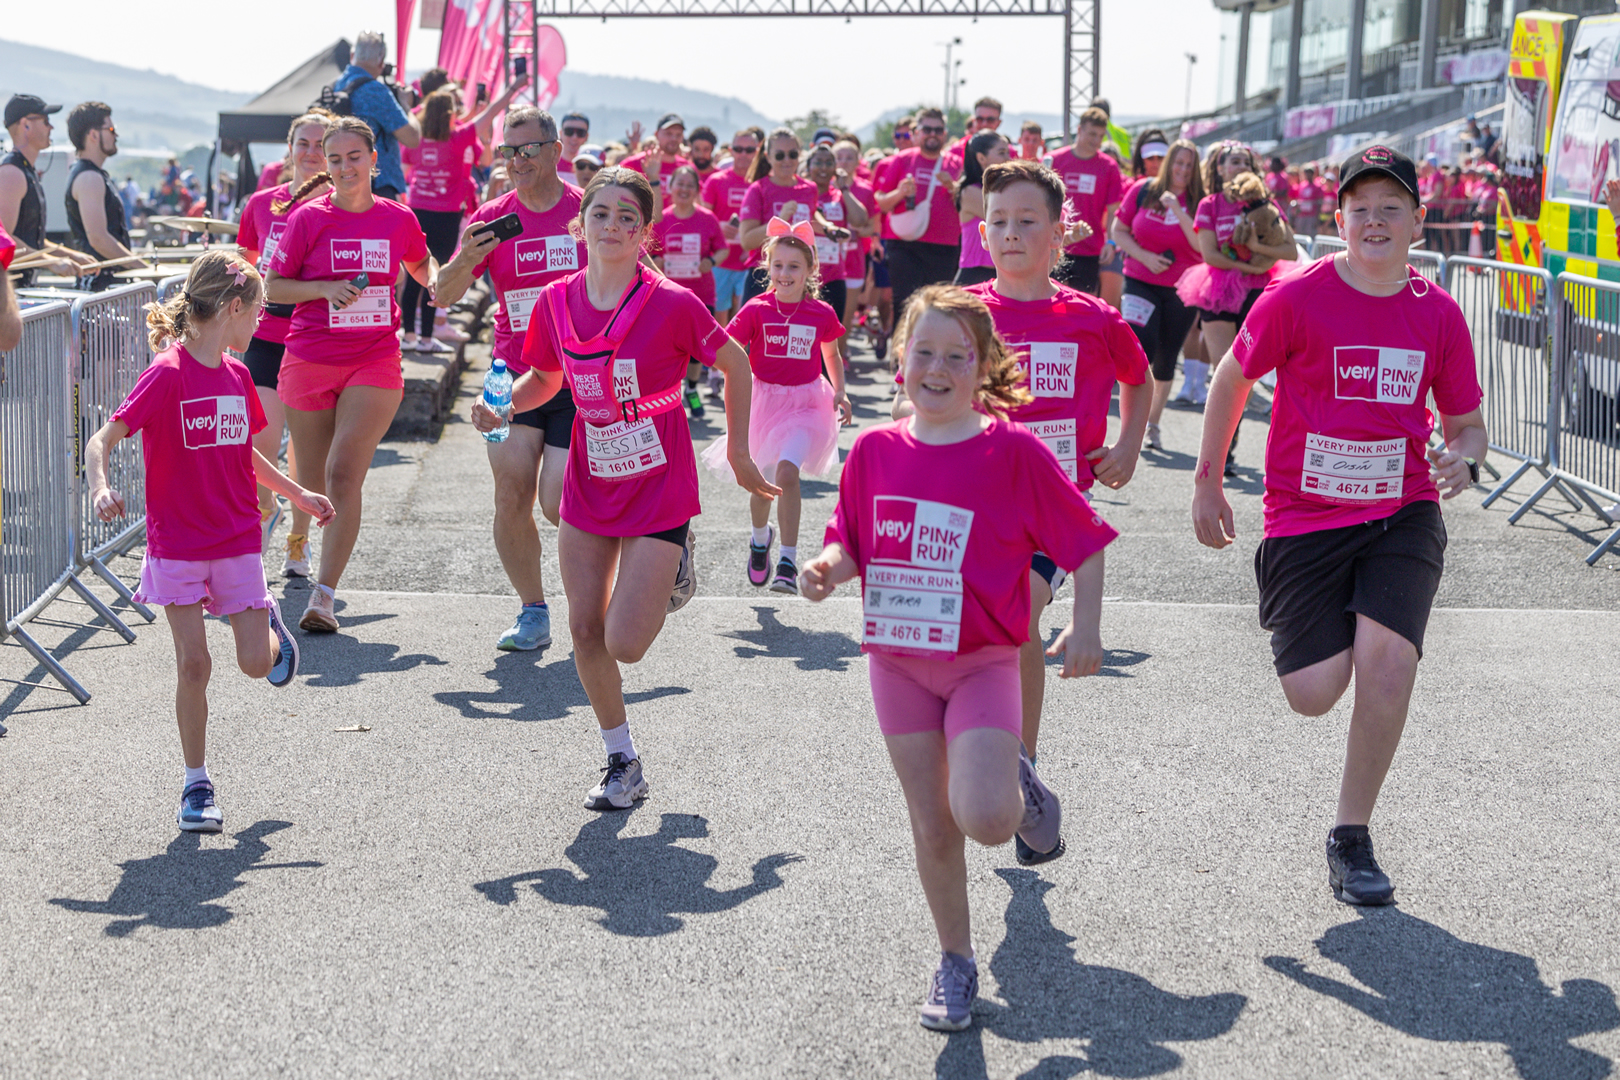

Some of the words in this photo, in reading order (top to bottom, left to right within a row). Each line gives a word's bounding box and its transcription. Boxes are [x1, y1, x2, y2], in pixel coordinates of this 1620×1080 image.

[334, 250, 360, 261] very
[365, 250, 388, 260] PINK
[518, 250, 545, 262] very
[549, 247, 574, 257] PINK
[365, 260, 386, 269] RUN
[549, 257, 572, 267] RUN
[350, 315, 369, 324] 6541
[766, 334, 788, 346] very
[791, 337, 812, 347] PINK
[790, 346, 807, 356] RUN
[1035, 362, 1072, 377] PINK
[1339, 365, 1376, 383] very
[1382, 368, 1418, 383] PINK
[614, 376, 634, 387] NK
[1036, 377, 1068, 392] RUN
[1381, 383, 1412, 398] RUN
[186, 414, 216, 431] very
[220, 413, 246, 426] PINK
[220, 427, 243, 439] RUN
[601, 425, 624, 438] PINK
[624, 419, 645, 430] RUN
[1043, 424, 1067, 434] RUN
[1316, 438, 1344, 451] VERY
[1347, 444, 1373, 454] PINK
[1376, 443, 1398, 453] RUN
[609, 460, 635, 473] 1610
[1336, 483, 1369, 495] 4674
[876, 519, 912, 543] very
[918, 525, 963, 549] PINK
[916, 544, 953, 562] RUN
[874, 571, 898, 583] VERY
[899, 574, 924, 586] PINK
[927, 577, 953, 588] RUN
[891, 625, 921, 641] 4676
